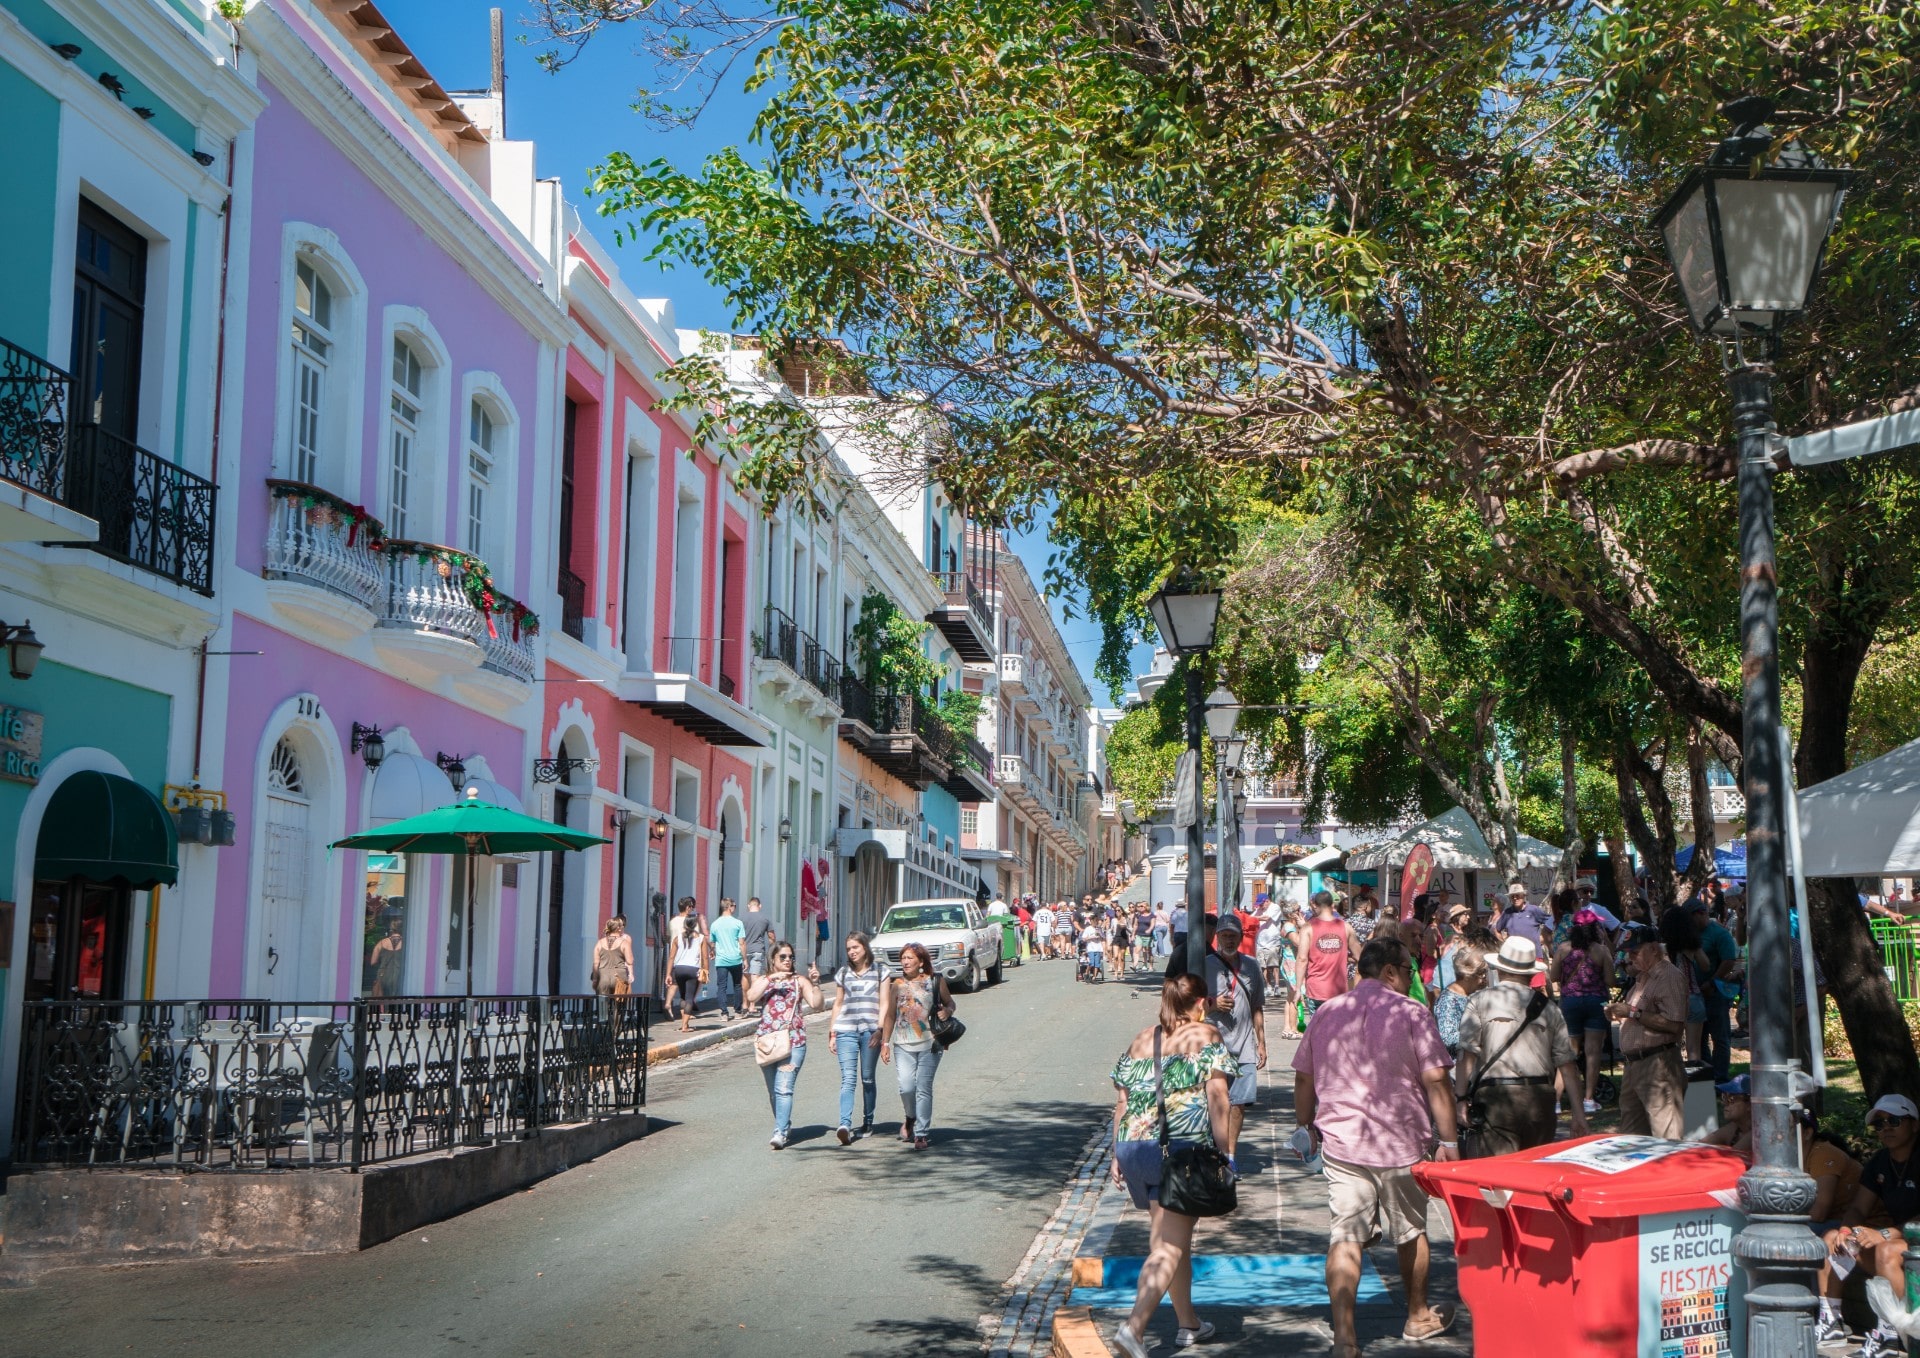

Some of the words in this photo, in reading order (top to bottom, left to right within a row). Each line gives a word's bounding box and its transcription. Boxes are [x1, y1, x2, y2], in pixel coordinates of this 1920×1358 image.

[298, 698, 320, 719] 206
[0, 709, 25, 741] fé
[7, 751, 41, 779] Rico
[1040, 915, 1048, 924] 51
[1673, 1214, 1714, 1240] AQUÍ
[1650, 1245, 1670, 1264] SE
[1674, 1238, 1730, 1260] RECICL
[1660, 1263, 1730, 1295] FIESTAS
[1663, 1328, 1675, 1339] DE
[1682, 1324, 1695, 1336] LA
